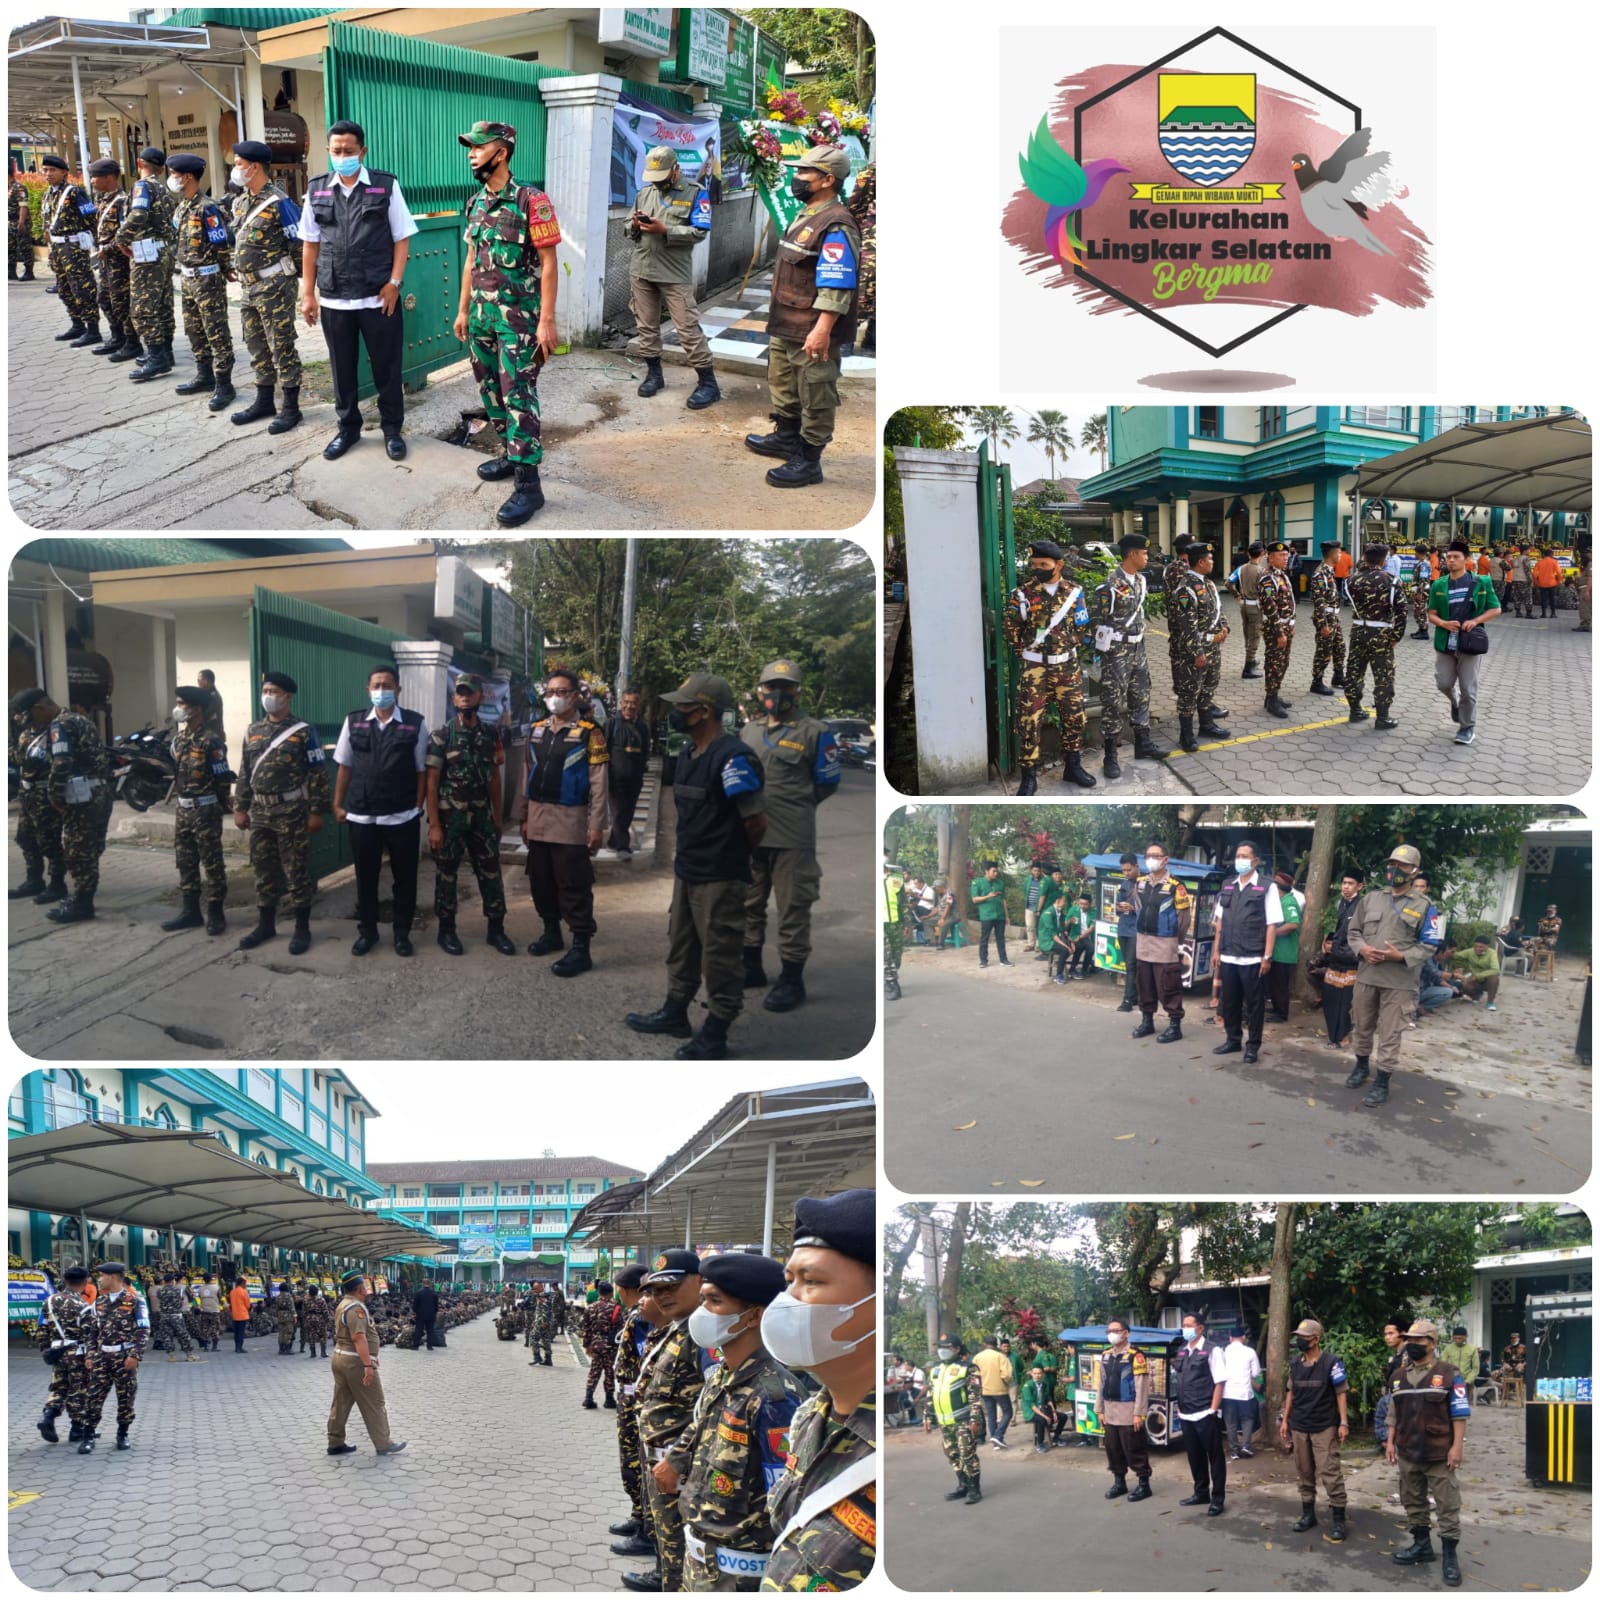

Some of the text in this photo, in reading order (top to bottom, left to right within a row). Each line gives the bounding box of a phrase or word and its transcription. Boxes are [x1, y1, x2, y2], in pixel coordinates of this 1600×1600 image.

[1155, 190, 1259, 201] GEMAH RIPAH WIBAWA MUKTI
[283, 221, 302, 239] PR
[1128, 209, 1289, 230] Kelurahan
[1086, 239, 1331, 263] Lingkar Selatan
[1151, 261, 1273, 301] Bergma
